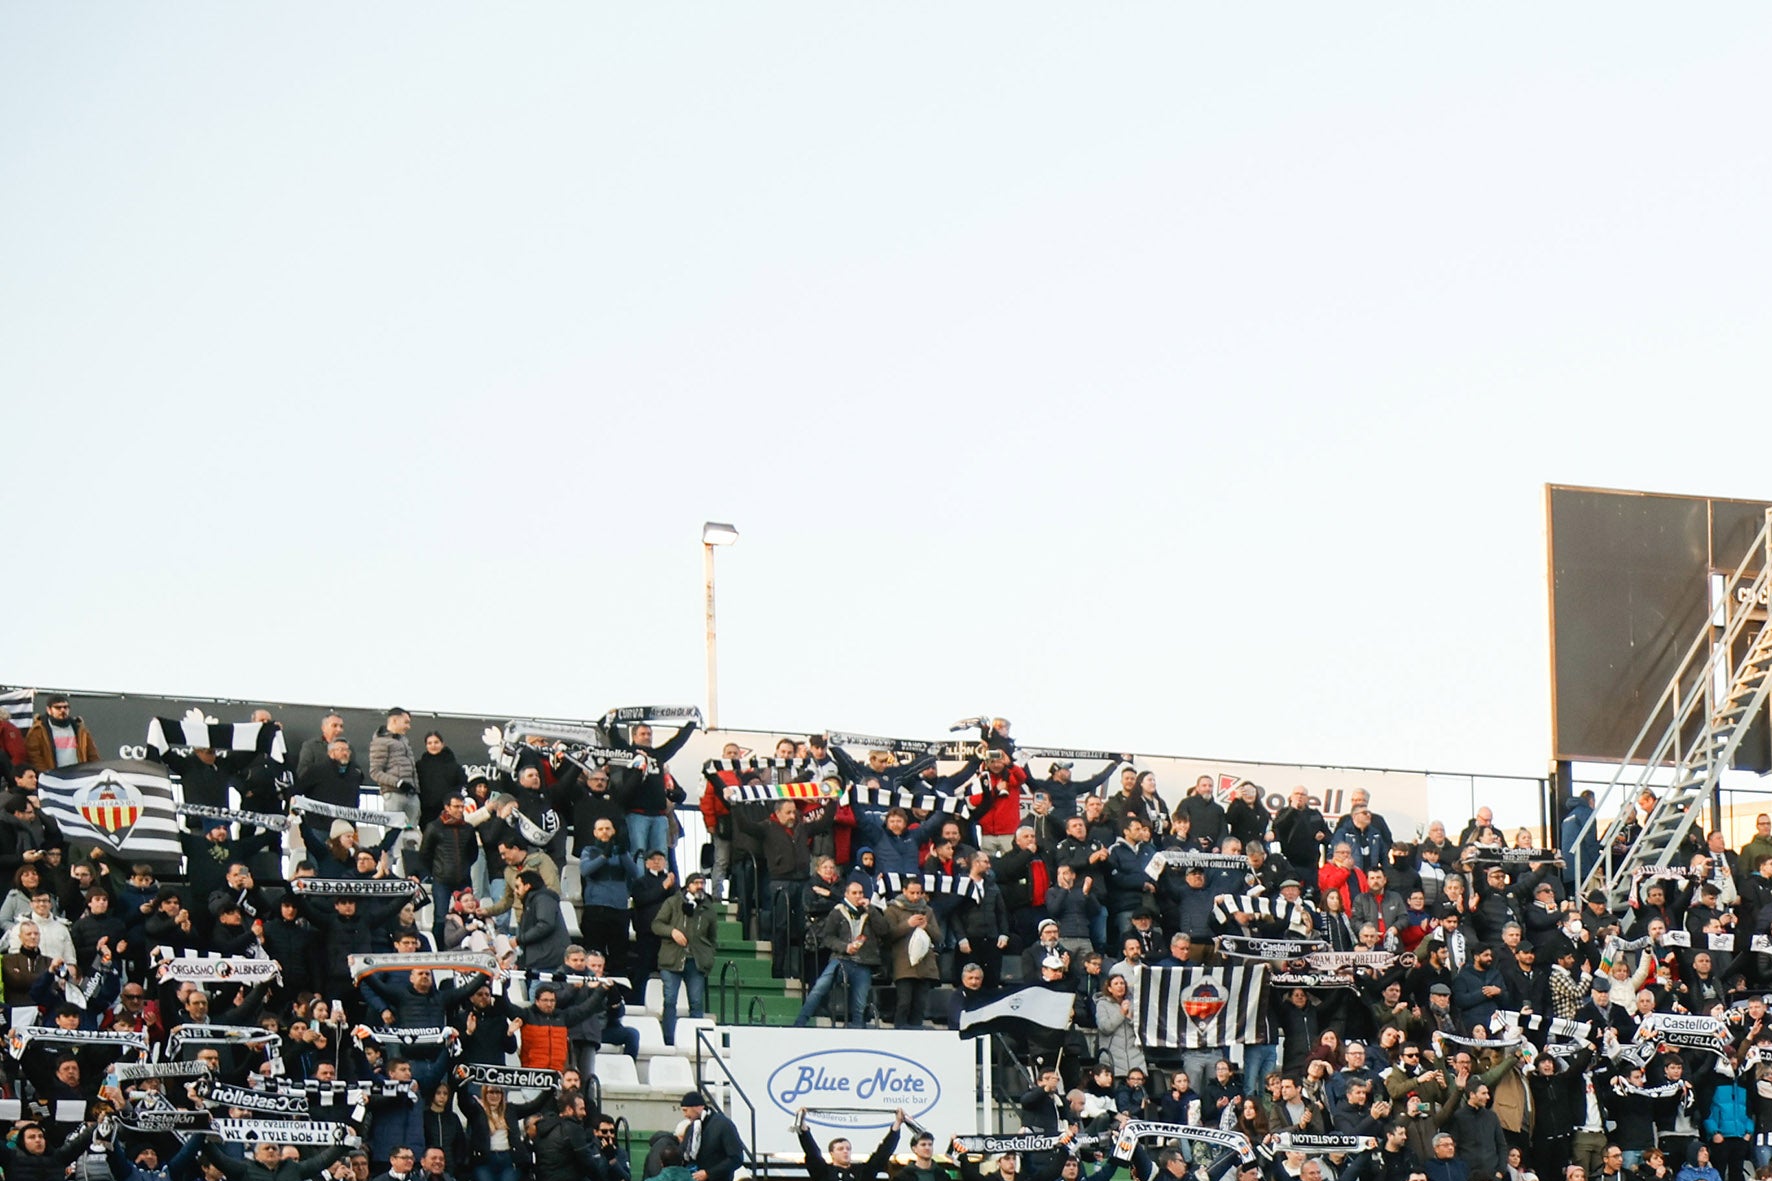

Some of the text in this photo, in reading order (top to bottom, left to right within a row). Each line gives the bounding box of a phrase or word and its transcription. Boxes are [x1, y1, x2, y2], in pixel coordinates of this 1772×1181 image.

[1248, 940, 1301, 953] CDCastellón
[172, 963, 216, 976] ORGASMO
[470, 1065, 553, 1088] CDCastellón
[780, 1065, 925, 1103] Blue Note
[882, 1094, 928, 1105] music bar
[1292, 1133, 1338, 1146] CASTELLON
